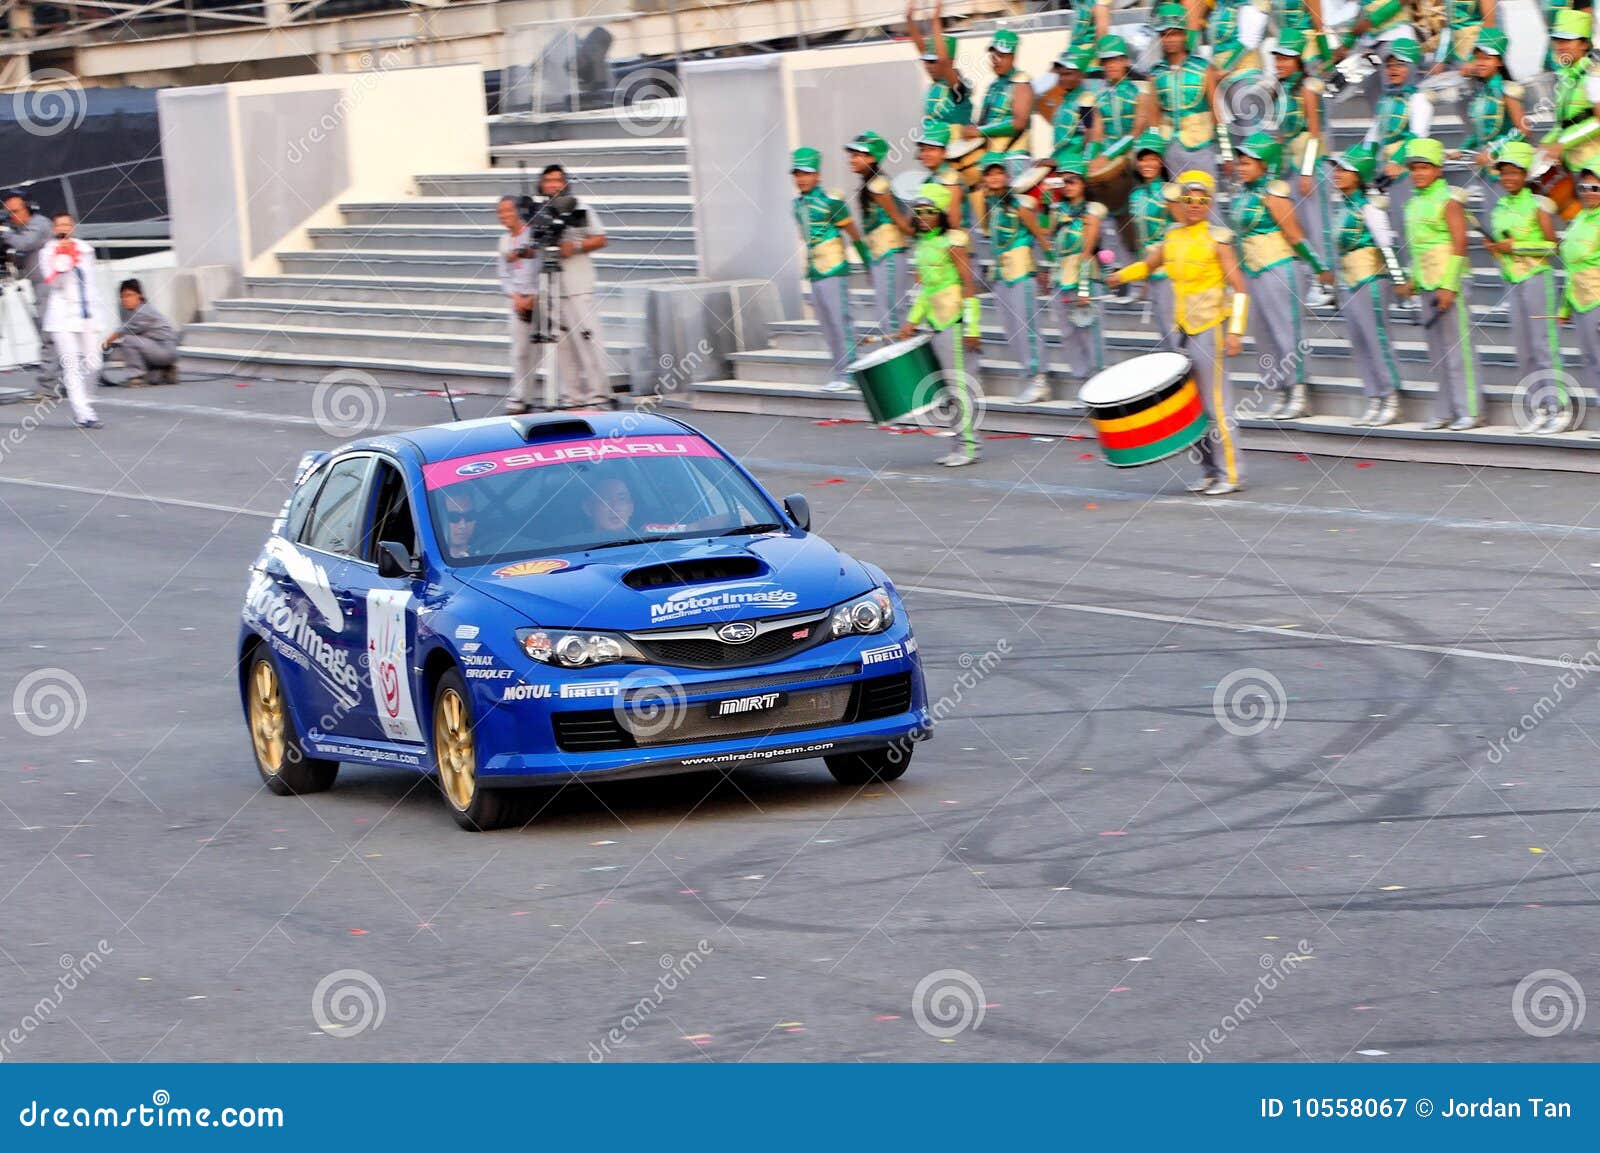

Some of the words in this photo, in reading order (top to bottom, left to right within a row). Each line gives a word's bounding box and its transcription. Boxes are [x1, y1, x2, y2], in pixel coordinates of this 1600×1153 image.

[503, 442, 688, 467] SUBARU
[651, 588, 798, 617] MotorImage
[465, 656, 493, 666] SONAX
[861, 643, 904, 665] PIRELLI
[503, 684, 552, 700] MOTUL
[560, 680, 620, 698] PIRELLI
[681, 742, 834, 766] www.miracingteam.com
